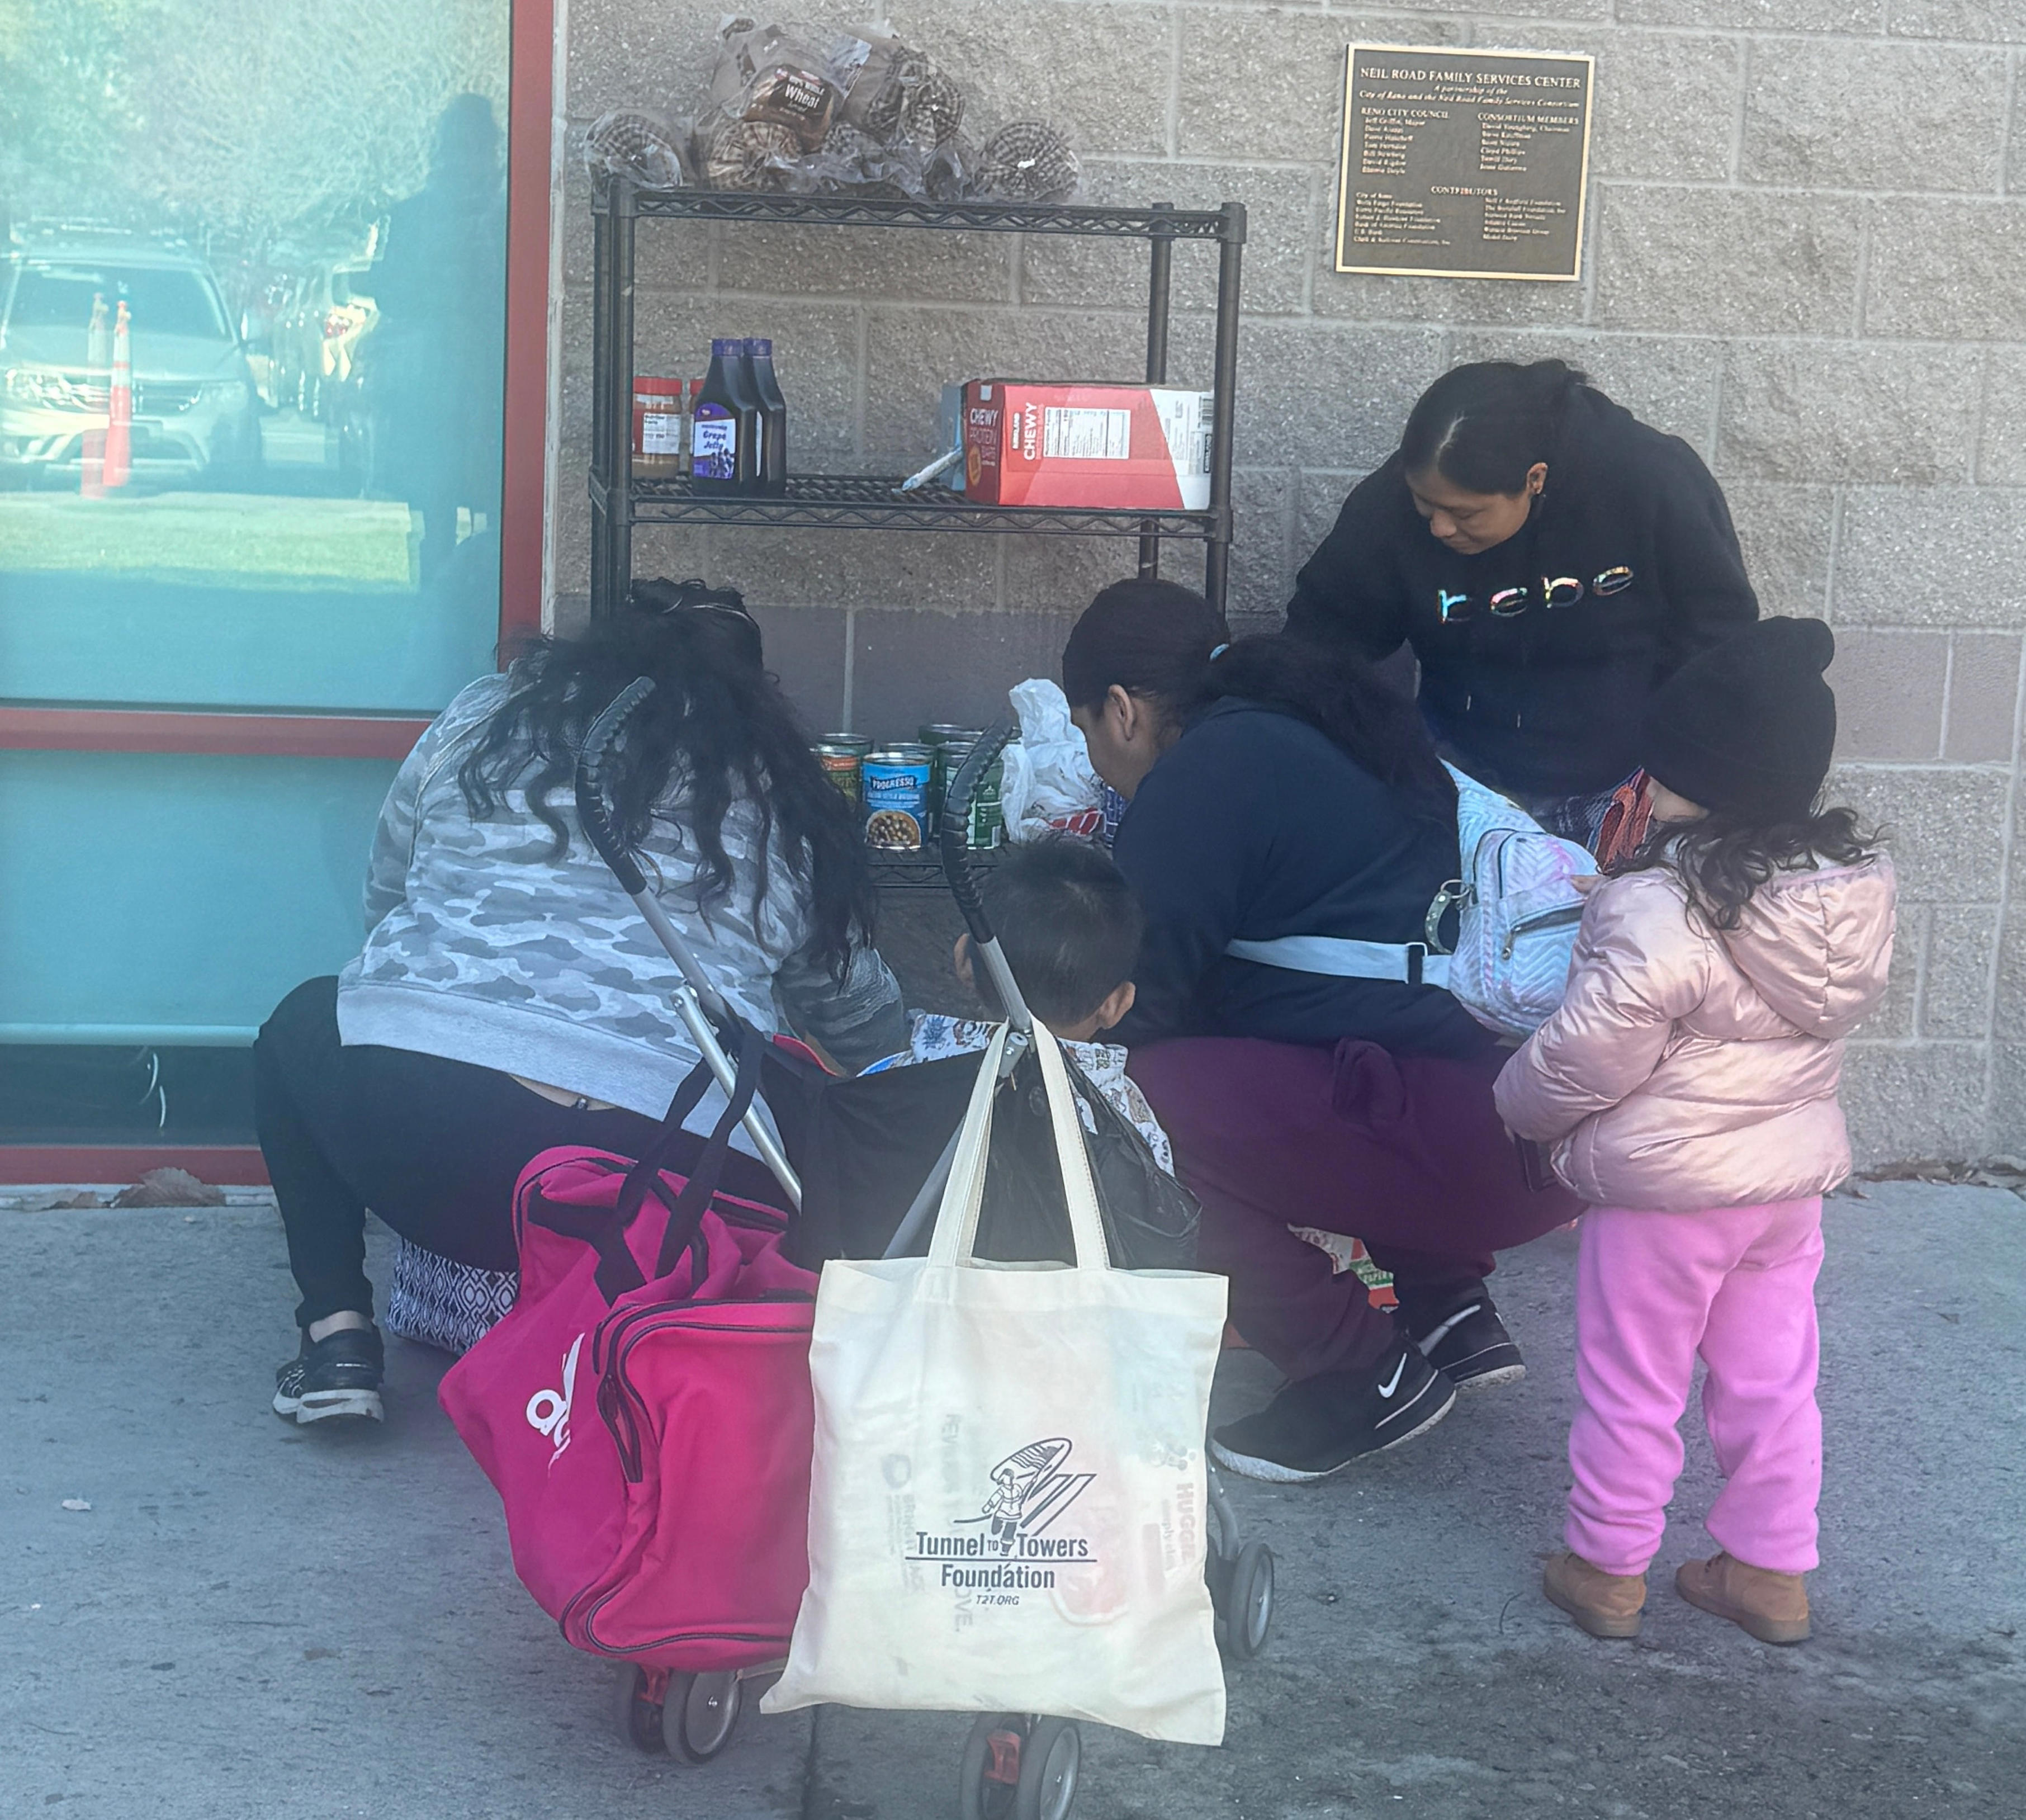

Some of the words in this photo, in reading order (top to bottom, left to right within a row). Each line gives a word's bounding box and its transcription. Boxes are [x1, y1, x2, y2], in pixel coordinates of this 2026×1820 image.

[1360, 68, 1389, 79] NEIL
[1391, 69, 1426, 81] ROAD
[1429, 70, 1473, 83] FAMILY
[1476, 73, 1532, 86] SERVICES
[1534, 76, 1580, 88] CENTER
[785, 84, 820, 108] Wheat
[1361, 107, 1386, 115] RENO
[1410, 109, 1450, 119] COUNCIL
[1431, 186, 1498, 196] CONTRIBUTORS
[970, 408, 998, 427] CHEWY
[703, 430, 726, 441] Grape
[1024, 402, 1038, 460] CHEWY
[703, 441, 724, 452] Jelly
[873, 776, 915, 790] PROGRESSO
[916, 1531, 985, 1556] Tunnel
[987, 1539, 999, 1552] TO
[1016, 1533, 1089, 1557] Towers
[941, 1563, 1055, 1589] Foundation
[976, 1595, 1020, 1606] T2T.ORG
